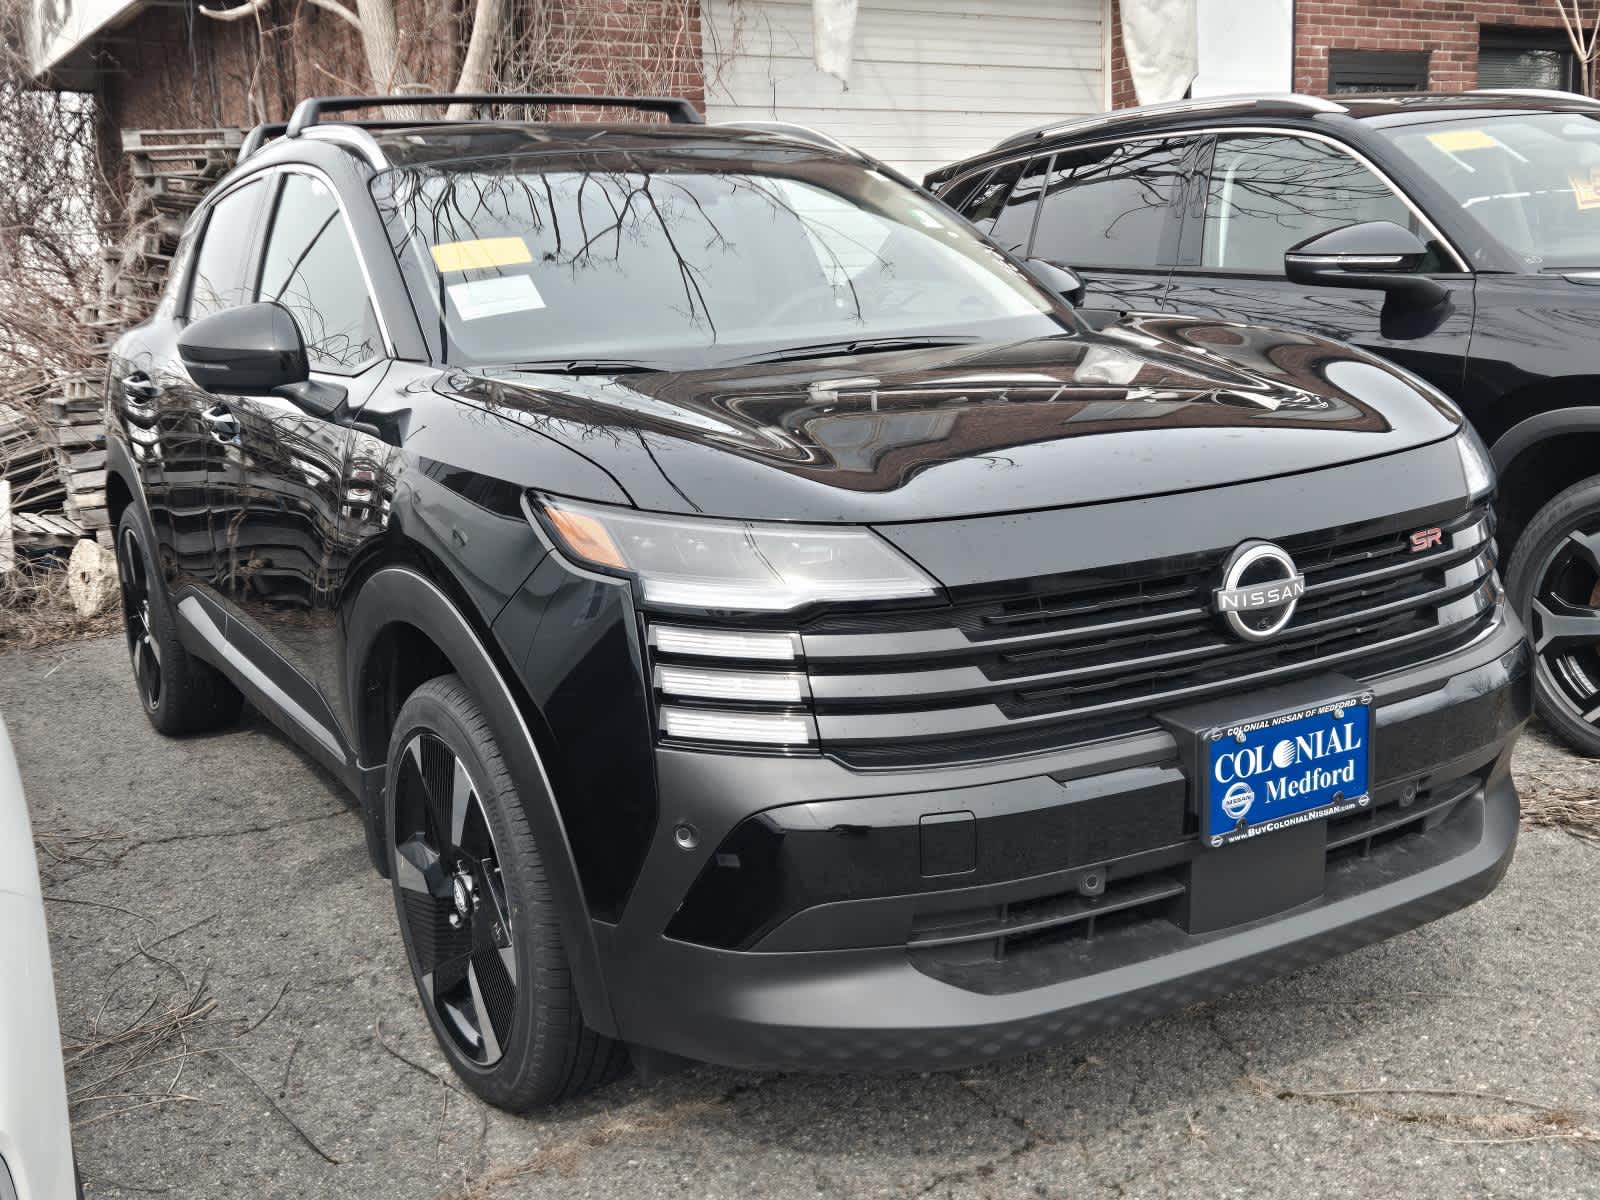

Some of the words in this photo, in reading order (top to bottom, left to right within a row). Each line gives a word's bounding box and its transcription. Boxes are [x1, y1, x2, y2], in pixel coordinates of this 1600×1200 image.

[1410, 527, 1442, 553] SR
[1221, 583, 1304, 609] NISSAN
[1227, 721, 1270, 736] COLONIAL
[1272, 712, 1304, 726] NISSAN
[1305, 709, 1317, 718] OF
[1318, 699, 1357, 715] MEDFORD
[1215, 722, 1361, 783] COLONIAL
[1265, 759, 1355, 804] Medford
[1225, 795, 1250, 806] NISSAN
